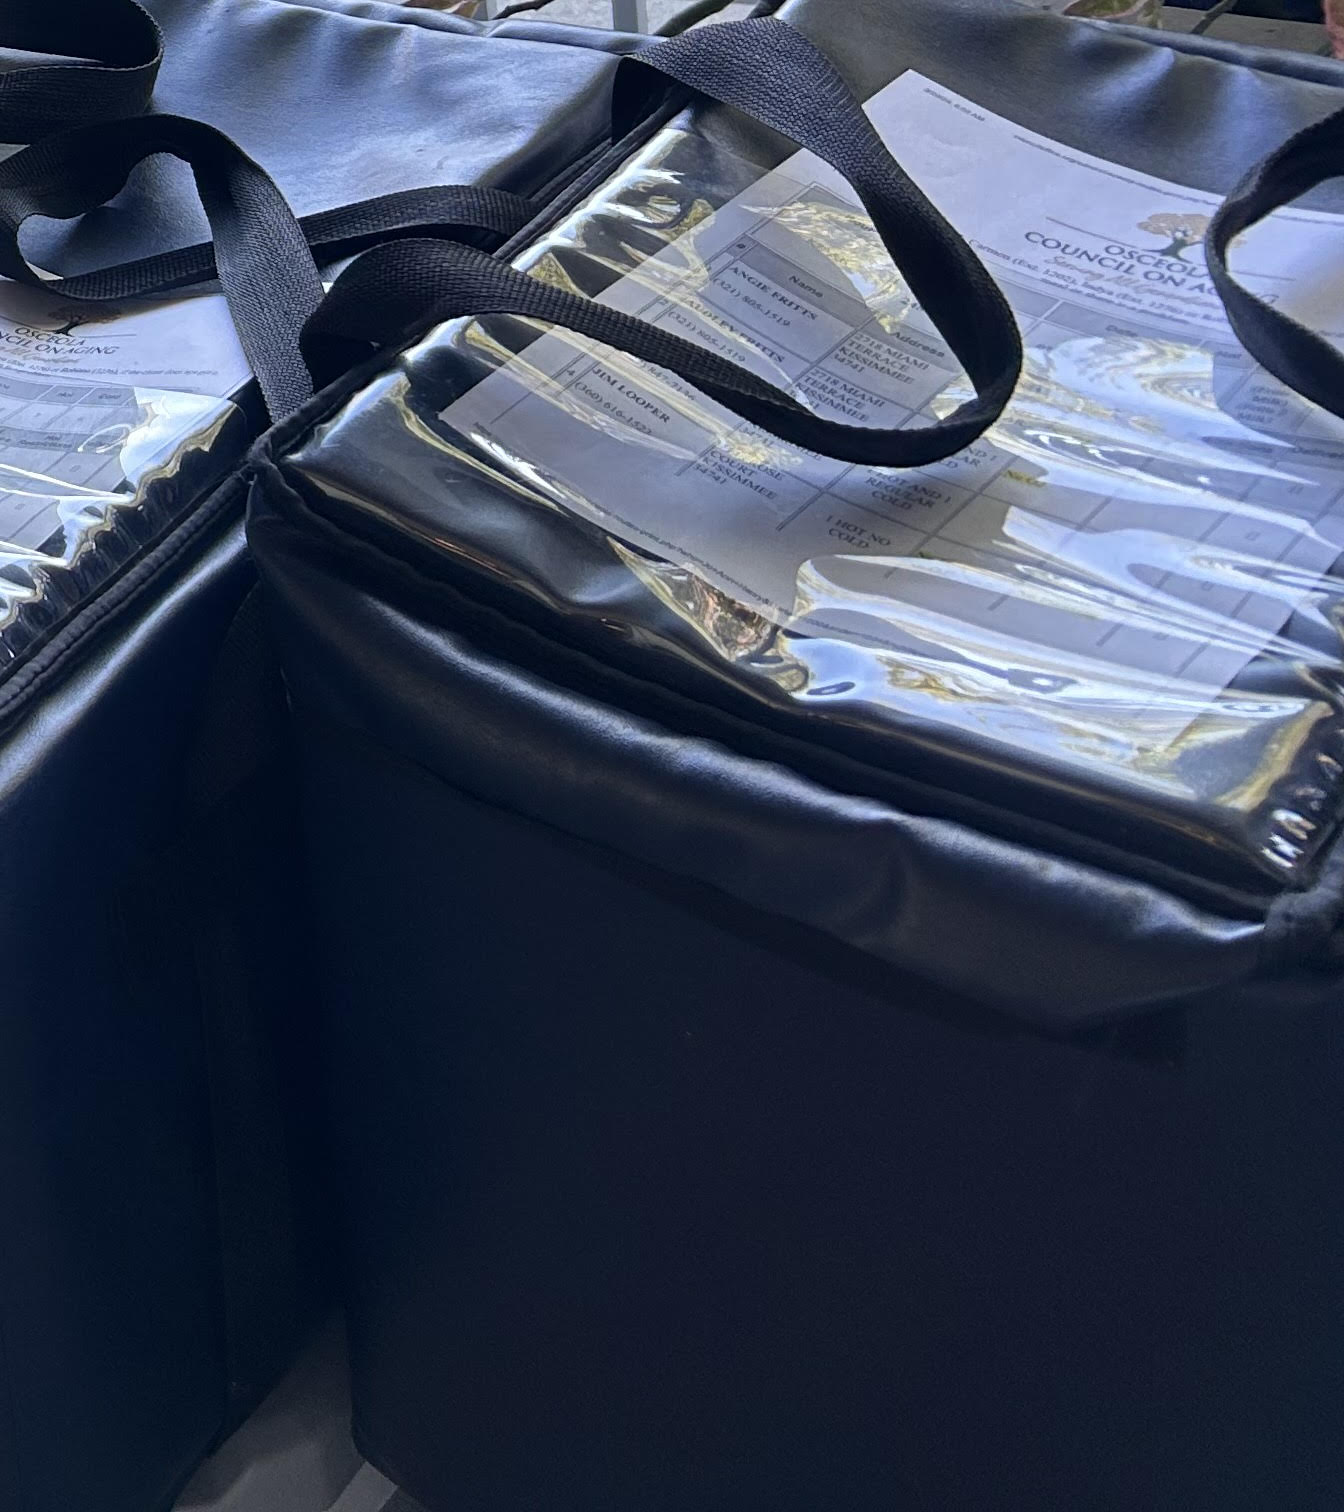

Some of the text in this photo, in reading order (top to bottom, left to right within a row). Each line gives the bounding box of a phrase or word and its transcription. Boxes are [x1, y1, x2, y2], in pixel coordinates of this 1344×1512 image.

[1024, 231, 1187, 287] COUNCIL ON
[1104, 244, 1210, 279] OSCEOL
[728, 267, 818, 321] ANGIE FRITTS
[789, 275, 824, 298] Name
[892, 331, 946, 358] Address
[15, 326, 86, 346] OSCEOLA
[35, 343, 62, 355] ON
[64, 345, 120, 355] AGING
[838, 346, 916, 385] KISSIMMEE
[846, 339, 912, 372] TERRACE
[884, 345, 931, 372] MIAMI
[592, 367, 619, 387] JIM
[617, 384, 671, 424] LOOPER
[794, 382, 871, 423] KISSIMMEE
[803, 375, 867, 411] TERRACE
[810, 367, 887, 409] 2718 MIAMI
[702, 456, 779, 500] KISSIMMEE
[710, 450, 757, 477] COURT
[865, 476, 935, 509] REGULAR
[871, 490, 913, 511] COLD
[911, 483, 943, 500] AND
[828, 527, 870, 549] COLD
[834, 518, 867, 536] HOT
[869, 532, 892, 547] NO
